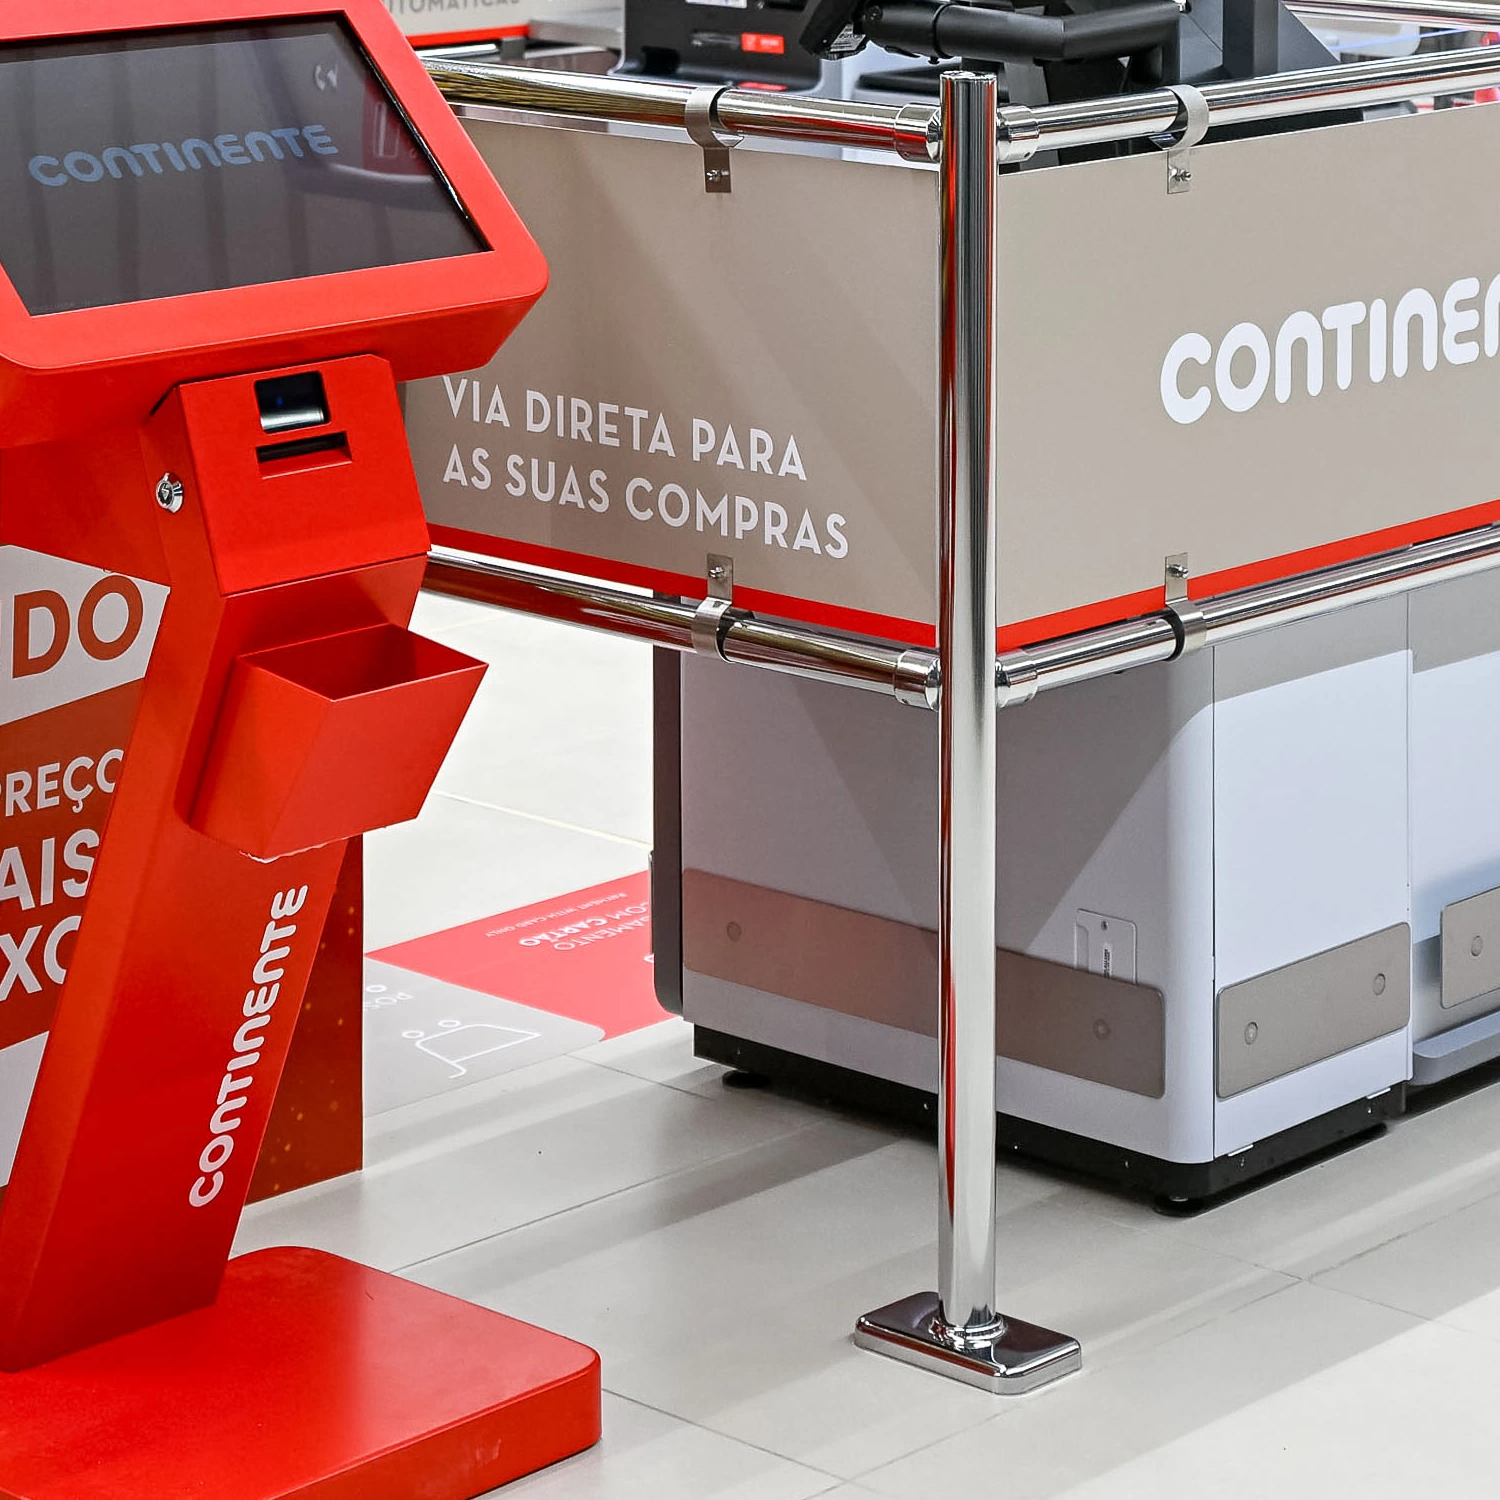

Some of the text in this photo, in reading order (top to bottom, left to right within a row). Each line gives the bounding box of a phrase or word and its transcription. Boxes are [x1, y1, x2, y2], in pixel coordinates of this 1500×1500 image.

[28, 123, 338, 188] CONTINENTE
[443, 376, 807, 481] VIA DIRETA PARA
[443, 443, 850, 560] AS SUAS COMPRAS
[518, 916, 608, 947] CARTÃO
[188, 882, 310, 1209] CONTINENTE
